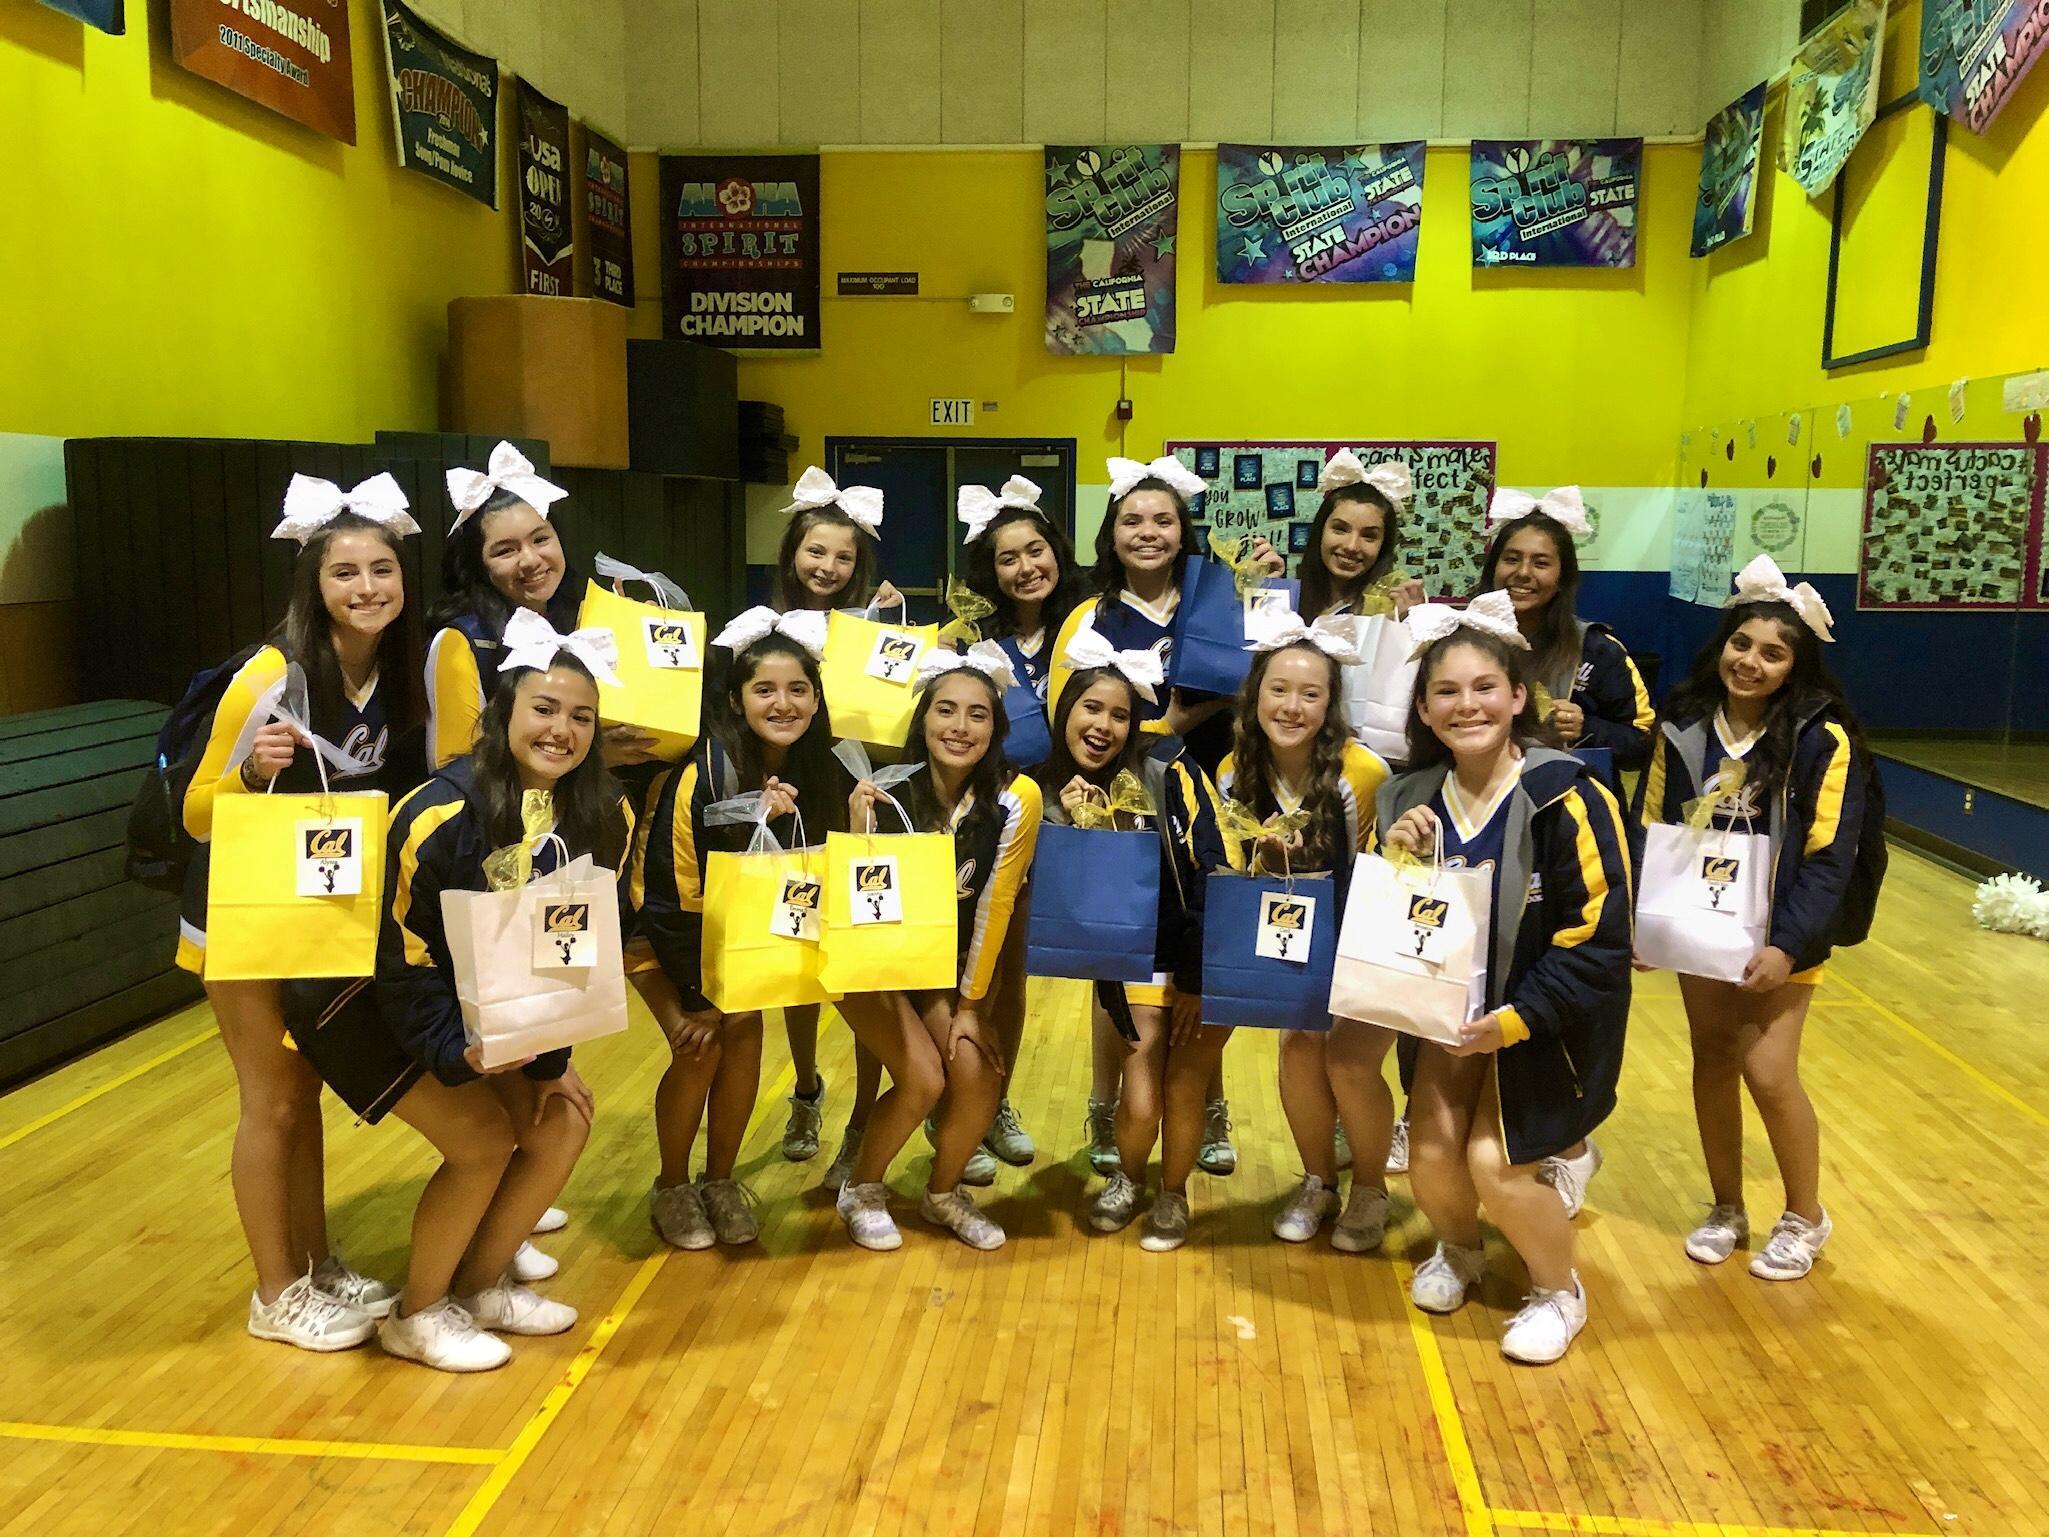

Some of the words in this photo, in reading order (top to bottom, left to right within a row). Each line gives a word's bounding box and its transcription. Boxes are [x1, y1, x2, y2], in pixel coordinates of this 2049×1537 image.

[221, 0, 331, 63] smanship
[219, 24, 243, 53] 2011
[243, 36, 286, 76] Specialty
[284, 57, 310, 88] Award
[1970, 0, 2049, 134] CHAMPIO
[1966, 34, 2007, 111] STATE
[400, 68, 483, 155] CHAMPION
[1363, 166, 1414, 201] STATE
[1590, 183, 1635, 206] STATE
[1110, 193, 1174, 237] International
[1285, 200, 1353, 240] International
[1521, 209, 1587, 240] International
[682, 231, 799, 259] SPIRIT
[1292, 225, 1347, 264] STATE
[1299, 203, 1421, 280] CHAMPION
[1509, 252, 1537, 261] PLACE
[530, 269, 560, 297] FIRST
[1092, 274, 1144, 288] CALIFORNIA
[691, 292, 793, 313] DIVISION
[1076, 288, 1146, 318] STATE
[680, 314, 804, 337] CHAMPION
[932, 400, 971, 423] EXIT
[1414, 467, 1460, 490] fect
[1235, 531, 1282, 564] gl!
[653, 625, 683, 644] Cal
[883, 640, 914, 660] Cal
[310, 829, 349, 859] Cal
[860, 866, 888, 891] Cal
[1705, 858, 1738, 881] Cal
[786, 882, 819, 907] Cal
[548, 904, 586, 932] Cal
[1271, 902, 1304, 928] Cal
[1410, 897, 1447, 926] Cal
